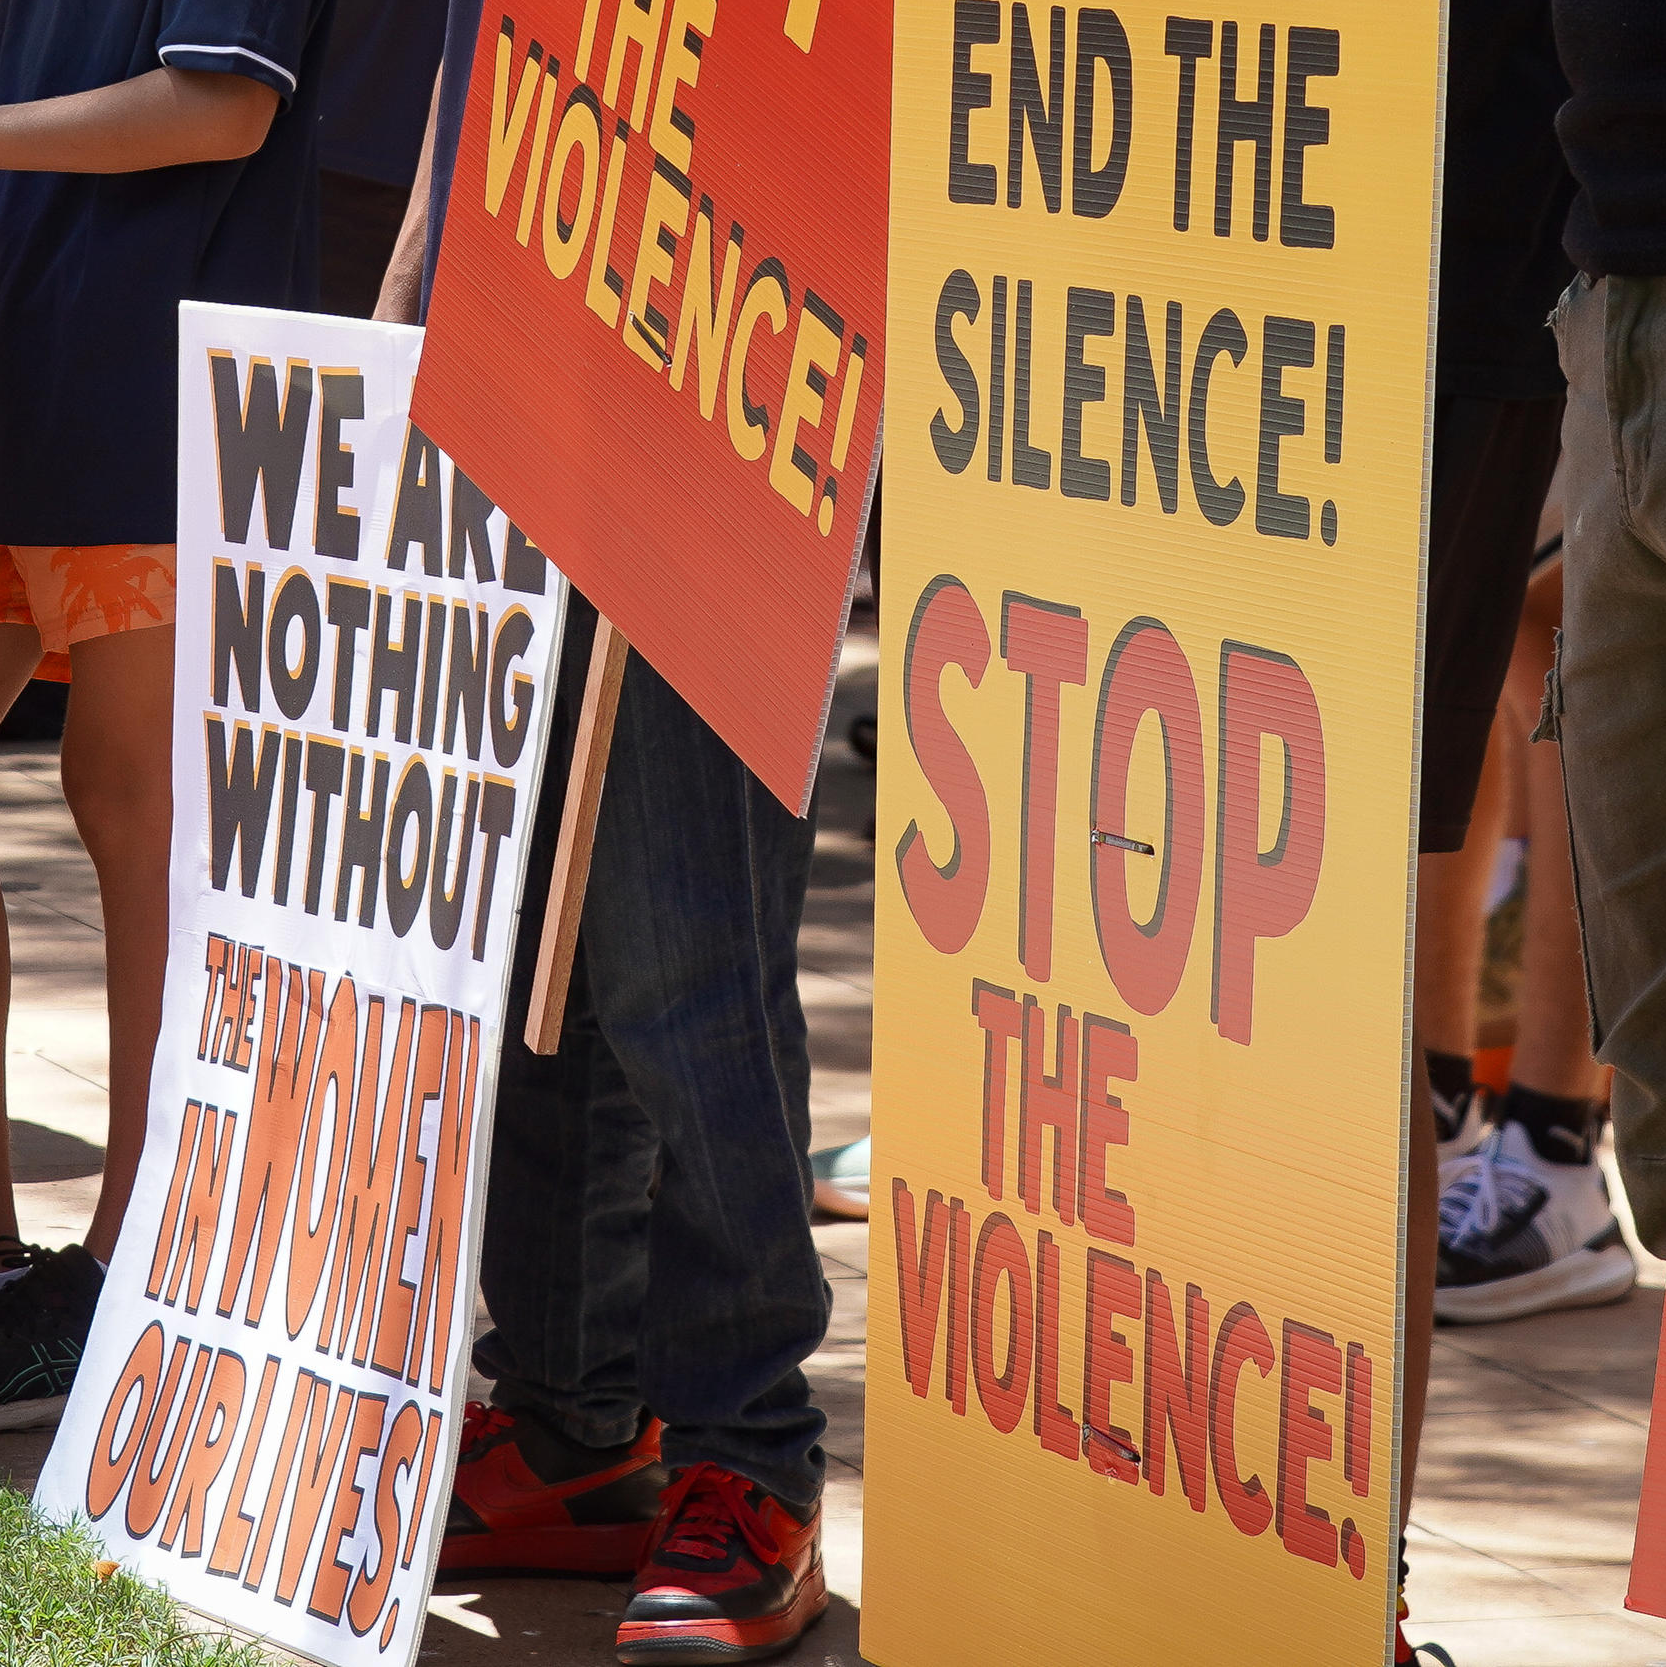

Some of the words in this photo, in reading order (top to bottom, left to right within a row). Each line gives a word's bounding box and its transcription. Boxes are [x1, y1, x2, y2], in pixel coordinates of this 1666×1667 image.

[1164, 16, 1340, 250] THE
[483, 16, 867, 536] VIOLENCE!
[930, 269, 1346, 548] SILENCE!
[205, 347, 366, 563] WE
[212, 556, 534, 767] NOTHING
[204, 711, 517, 961] WITHOUT
[895, 574, 1327, 1046] STOP
[197, 932, 264, 1076] THE
[972, 978, 1138, 1248] THE
[146, 1096, 238, 1318] IN
[217, 958, 482, 1397] WOMEN
[85, 1319, 247, 1559] OUR
[212, 1351, 442, 1654] LIVES!
[893, 1177, 1372, 1581] VIOLENCE!
